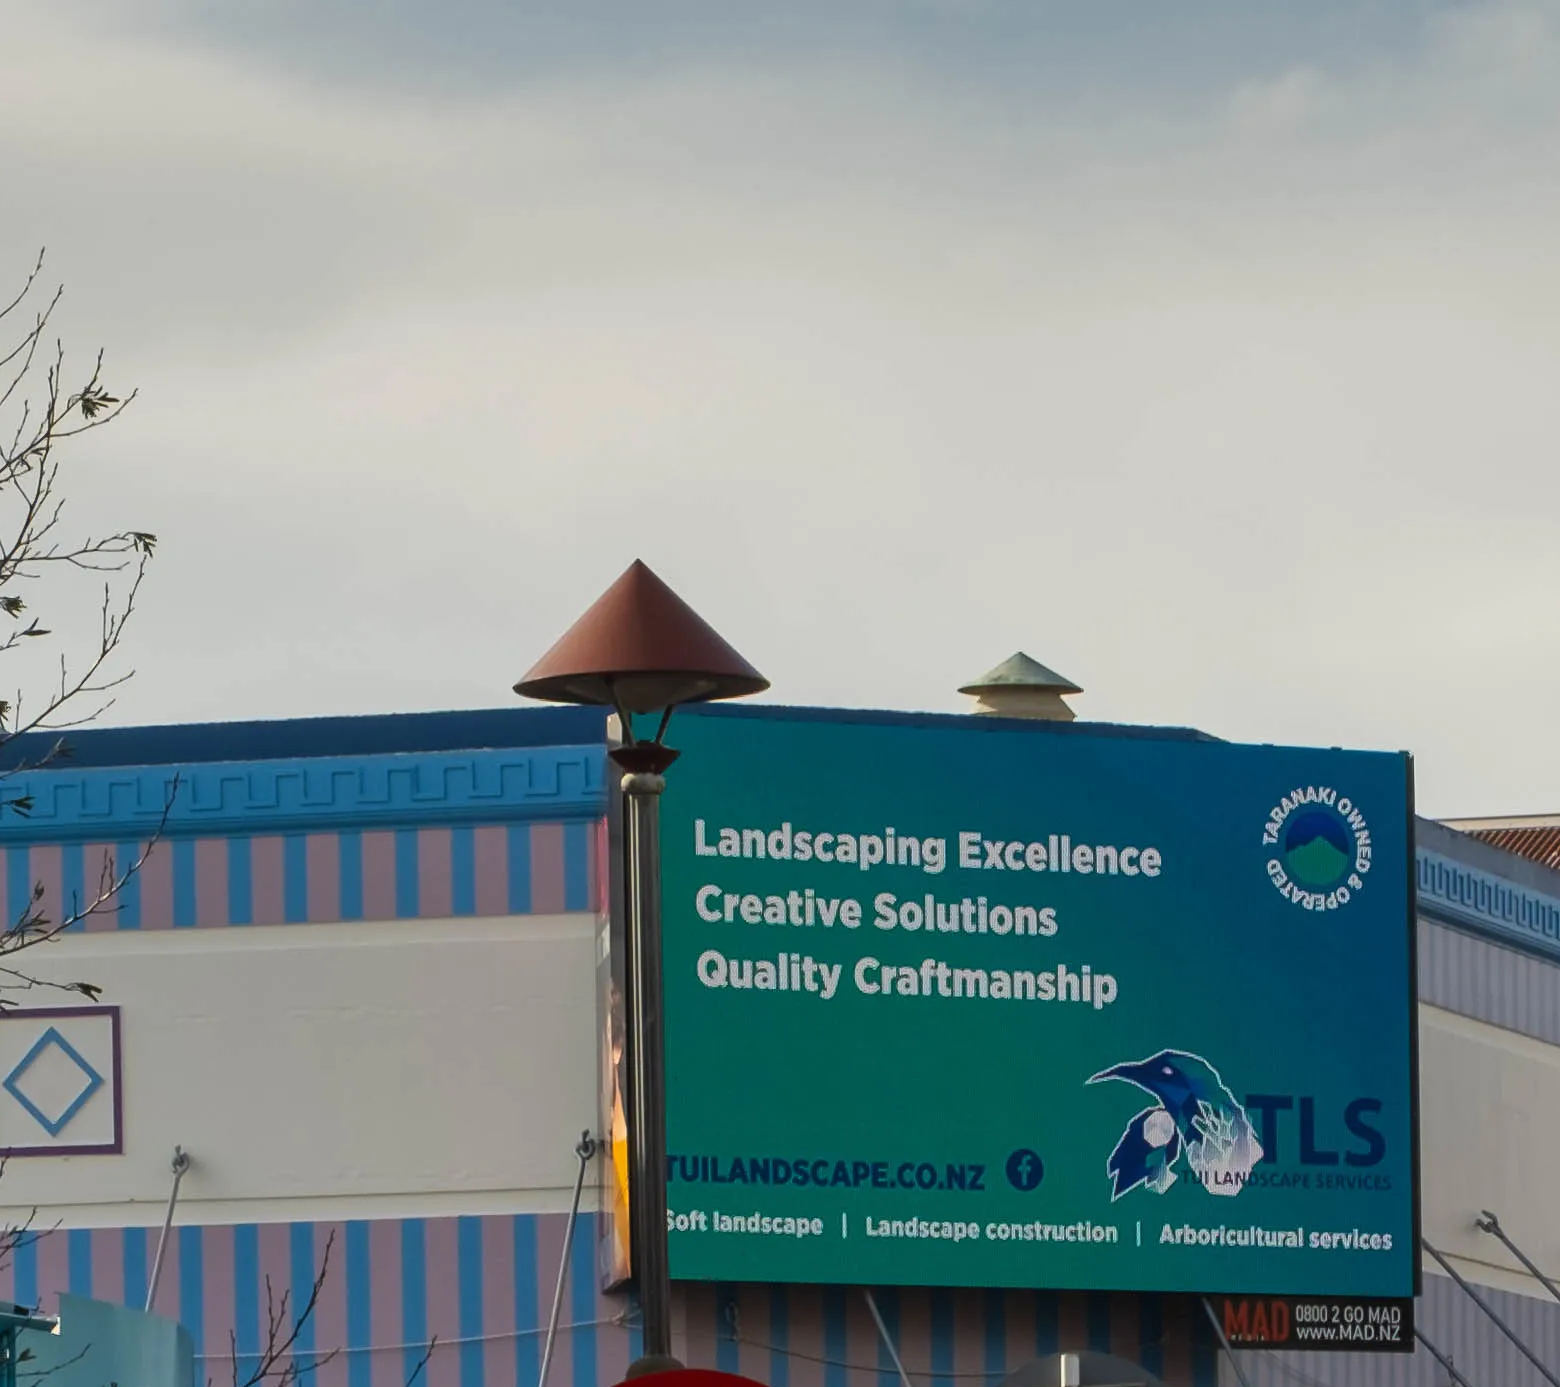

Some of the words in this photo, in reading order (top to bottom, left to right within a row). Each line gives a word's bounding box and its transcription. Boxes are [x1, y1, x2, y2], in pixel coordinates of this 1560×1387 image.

[1263, 786, 1336, 846] TARANAKI
[1337, 798, 1372, 873] OWNED
[693, 818, 947, 874] Landscaping
[958, 831, 1162, 877] Excellence
[694, 885, 862, 930] Creative
[873, 892, 1059, 937] Solutions
[1267, 859, 1351, 912] OPERATED
[696, 951, 842, 1000] Quality
[853, 957, 1118, 1008] Craftmanship
[1245, 1094, 1387, 1168] TLS
[665, 1154, 986, 1191] TUILANDSCAPE.CO.NZ
[1214, 1170, 1312, 1190] LANDSCAPE
[1316, 1173, 1392, 1191] SERVICES
[666, 1209, 708, 1232] Soft
[712, 1211, 823, 1239] landscape
[866, 1216, 980, 1242] Landscape
[985, 1219, 1118, 1246] construction
[1159, 1223, 1304, 1248] Arboricultural
[1309, 1228, 1393, 1251] services
[1224, 1300, 1289, 1342] MAD
[1295, 1304, 1328, 1322] 0800
[1331, 1306, 1341, 1322] 2
[1343, 1306, 1364, 1323] GO
[1368, 1307, 1401, 1324] MAD
[1296, 1324, 1401, 1342] www.MAD.NZ
